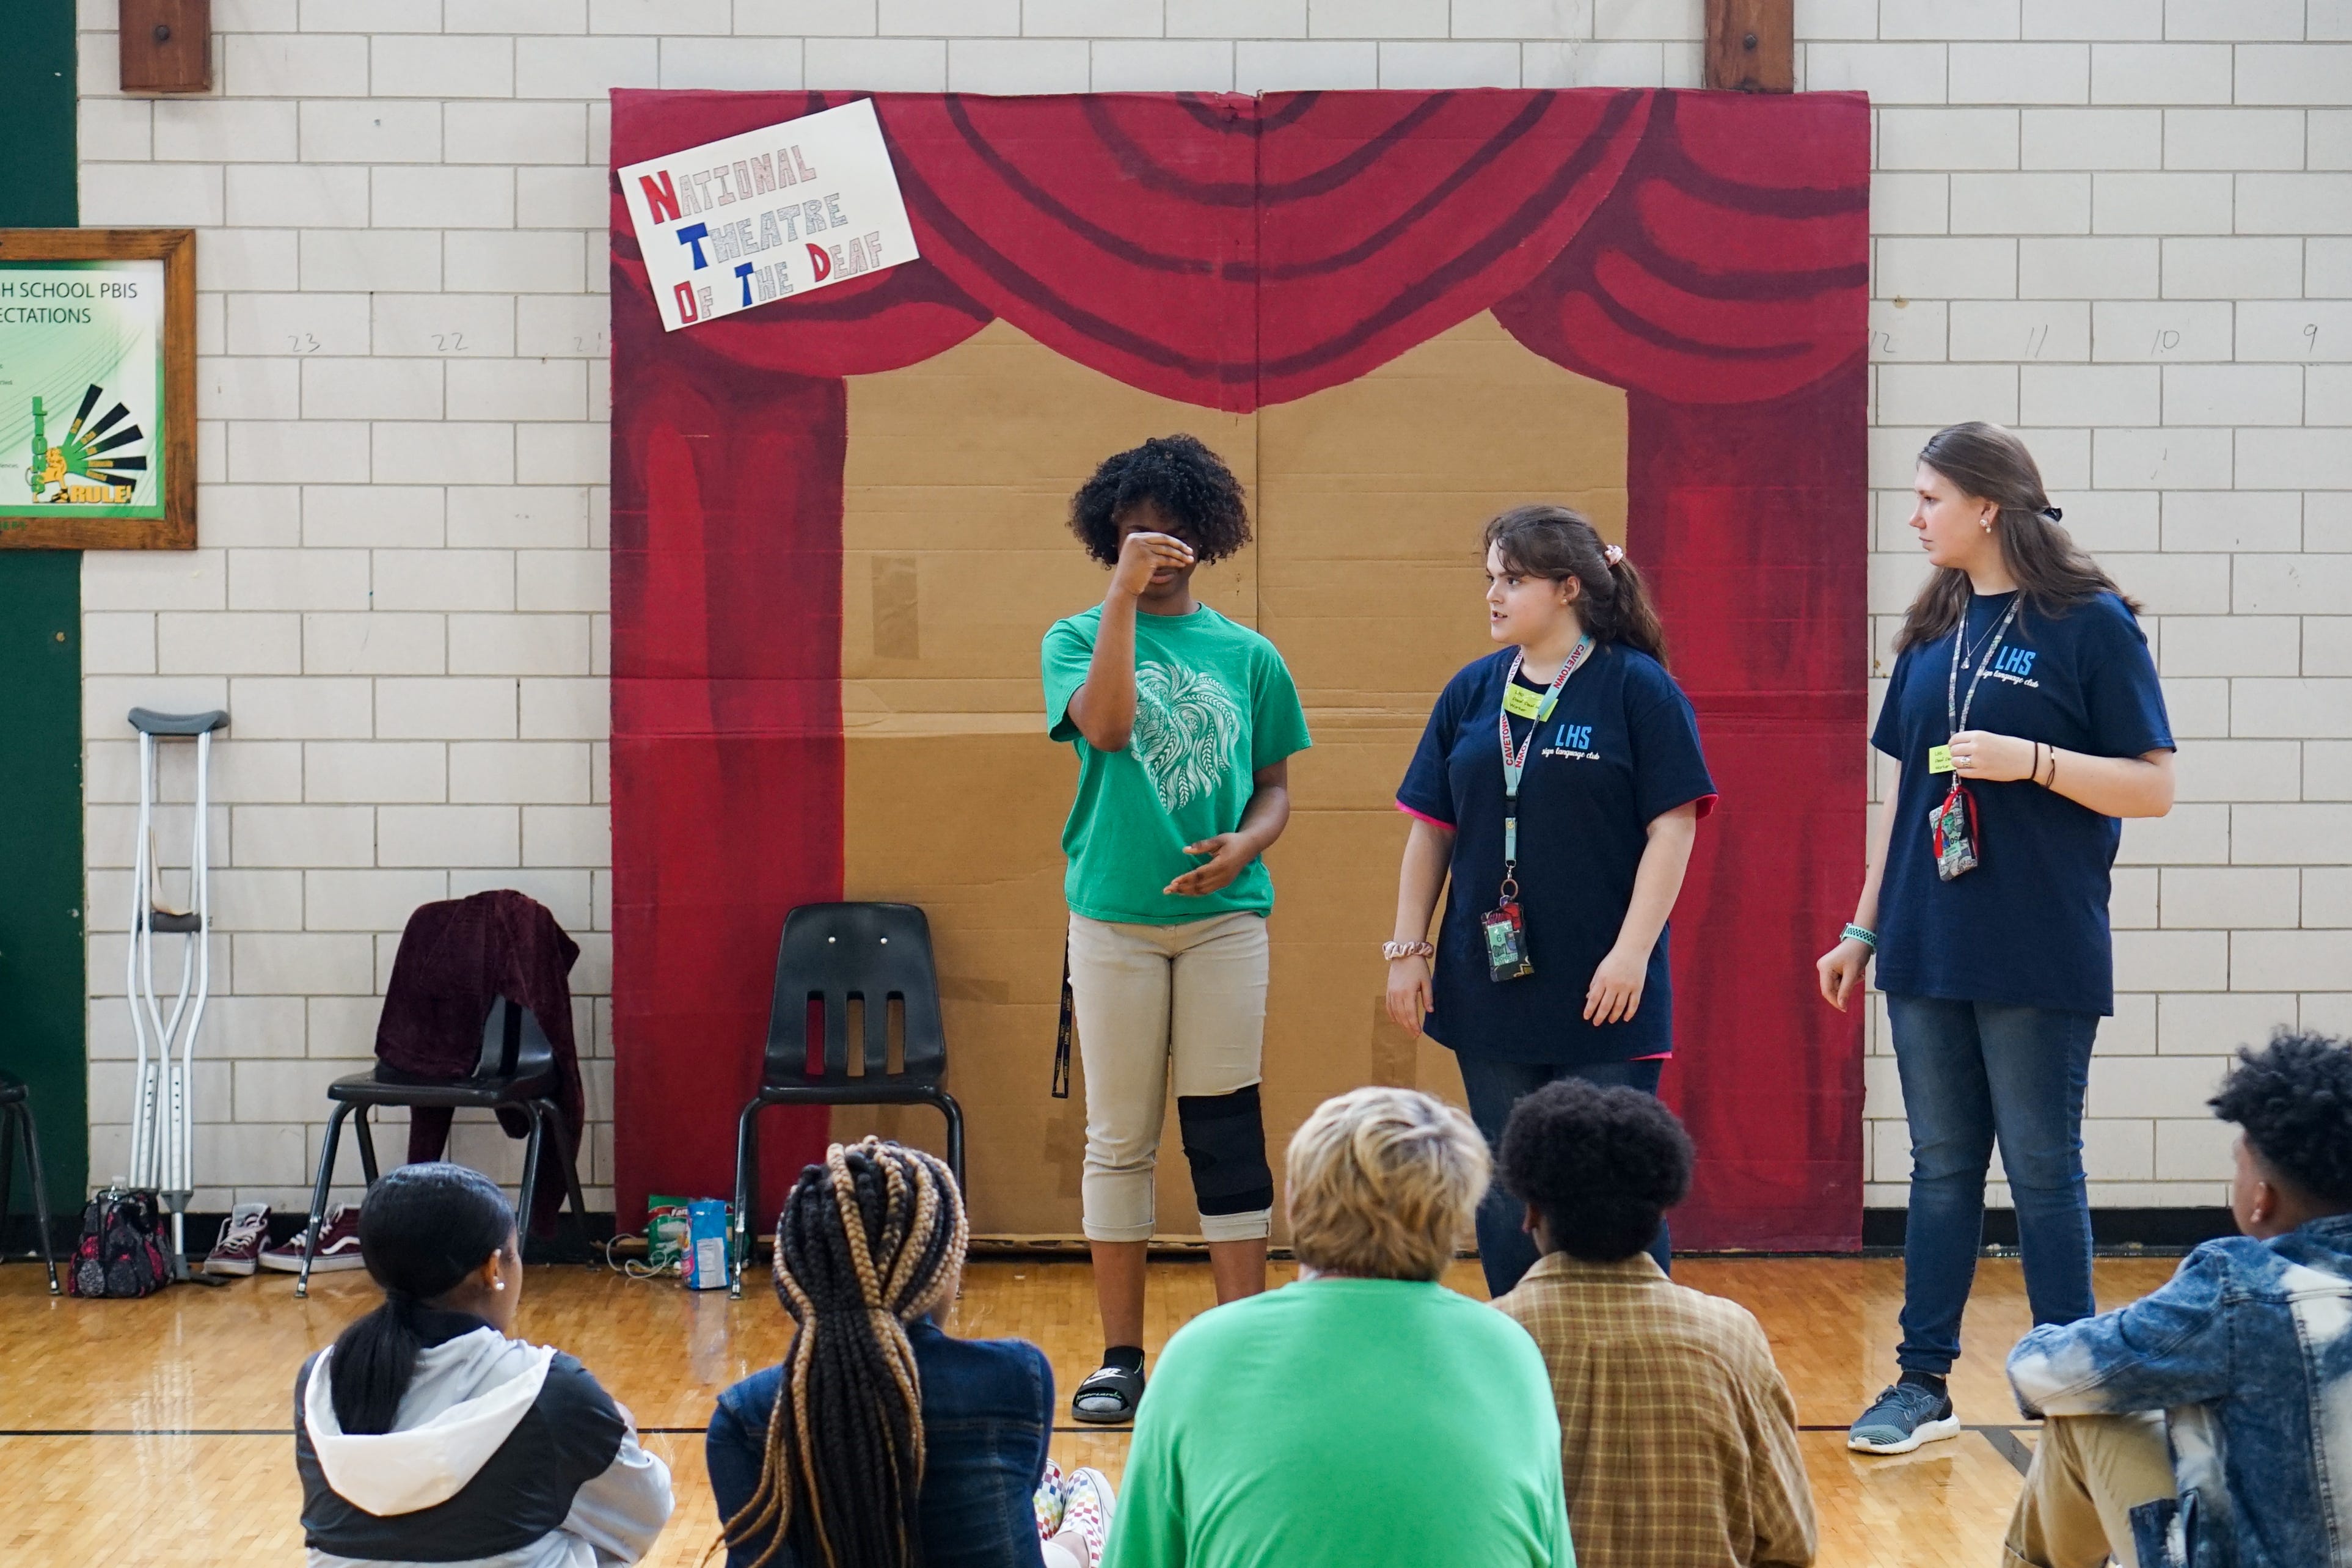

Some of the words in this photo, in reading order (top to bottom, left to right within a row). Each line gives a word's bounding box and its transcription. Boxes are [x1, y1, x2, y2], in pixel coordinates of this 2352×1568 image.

[638, 145, 817, 225] NATIONAL
[676, 193, 848, 271] THEATRE
[20, 282, 95, 298] SCHOOL
[100, 283, 137, 299] PBIS
[674, 280, 714, 324] OF
[734, 261, 794, 307] THE
[805, 231, 882, 283] DEAF
[288, 333, 321, 353] 23
[431, 332, 469, 351] 22
[2303, 323, 2318, 354] 9
[31, 396, 48, 494] LIONS
[70, 485, 132, 503] RULE!
[1553, 644, 1584, 689] CAVETOWN
[1995, 646, 2036, 676] LHS
[1993, 670, 2024, 685] language
[2024, 679, 2039, 688] club
[1501, 714, 1514, 766] CAVETOWN
[1555, 724, 1592, 750] LHS
[1541, 748, 1555, 758] sign
[1555, 747, 1586, 760] language
[1586, 752, 1600, 760] club
